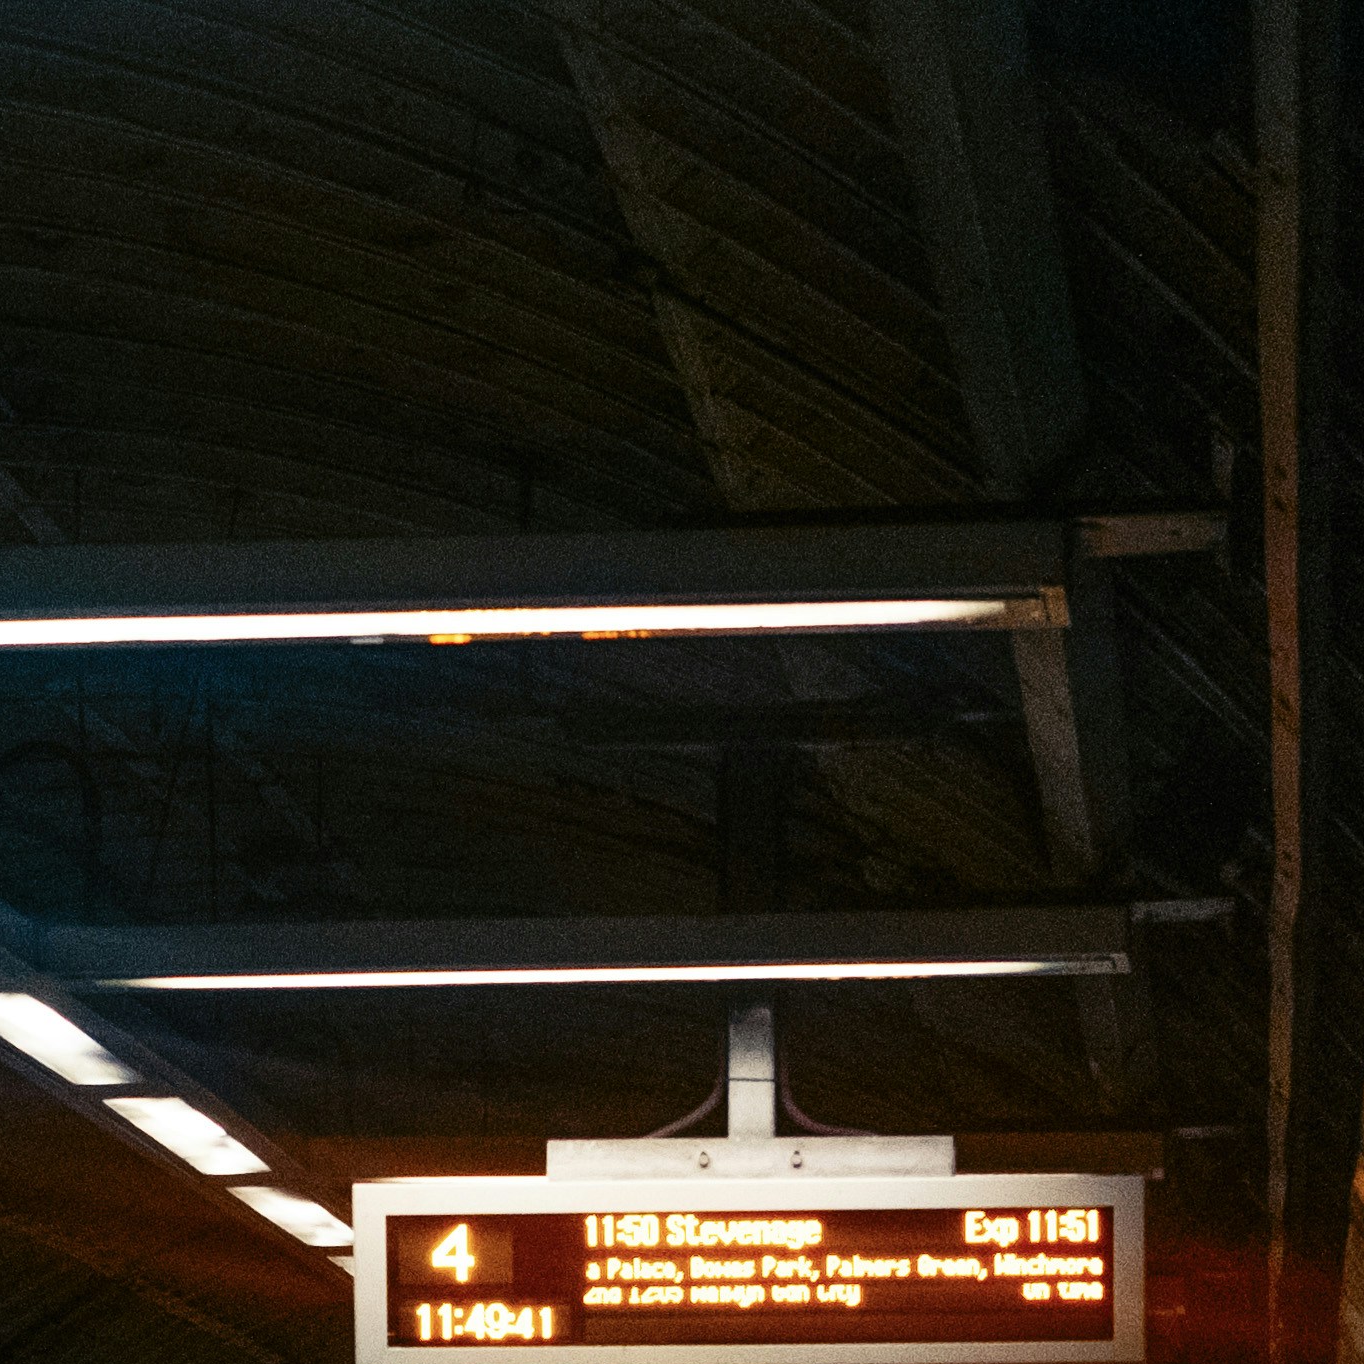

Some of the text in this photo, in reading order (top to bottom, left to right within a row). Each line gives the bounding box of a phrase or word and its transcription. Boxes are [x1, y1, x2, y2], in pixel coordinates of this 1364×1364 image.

[585, 1213, 823, 1250] 11:50 Stevenage
[964, 1209, 1099, 1248] Exp 11:51
[430, 1223, 476, 1284] 4
[760, 1255, 820, 1283] Park,
[415, 1302, 553, 1342] 11:49:41
